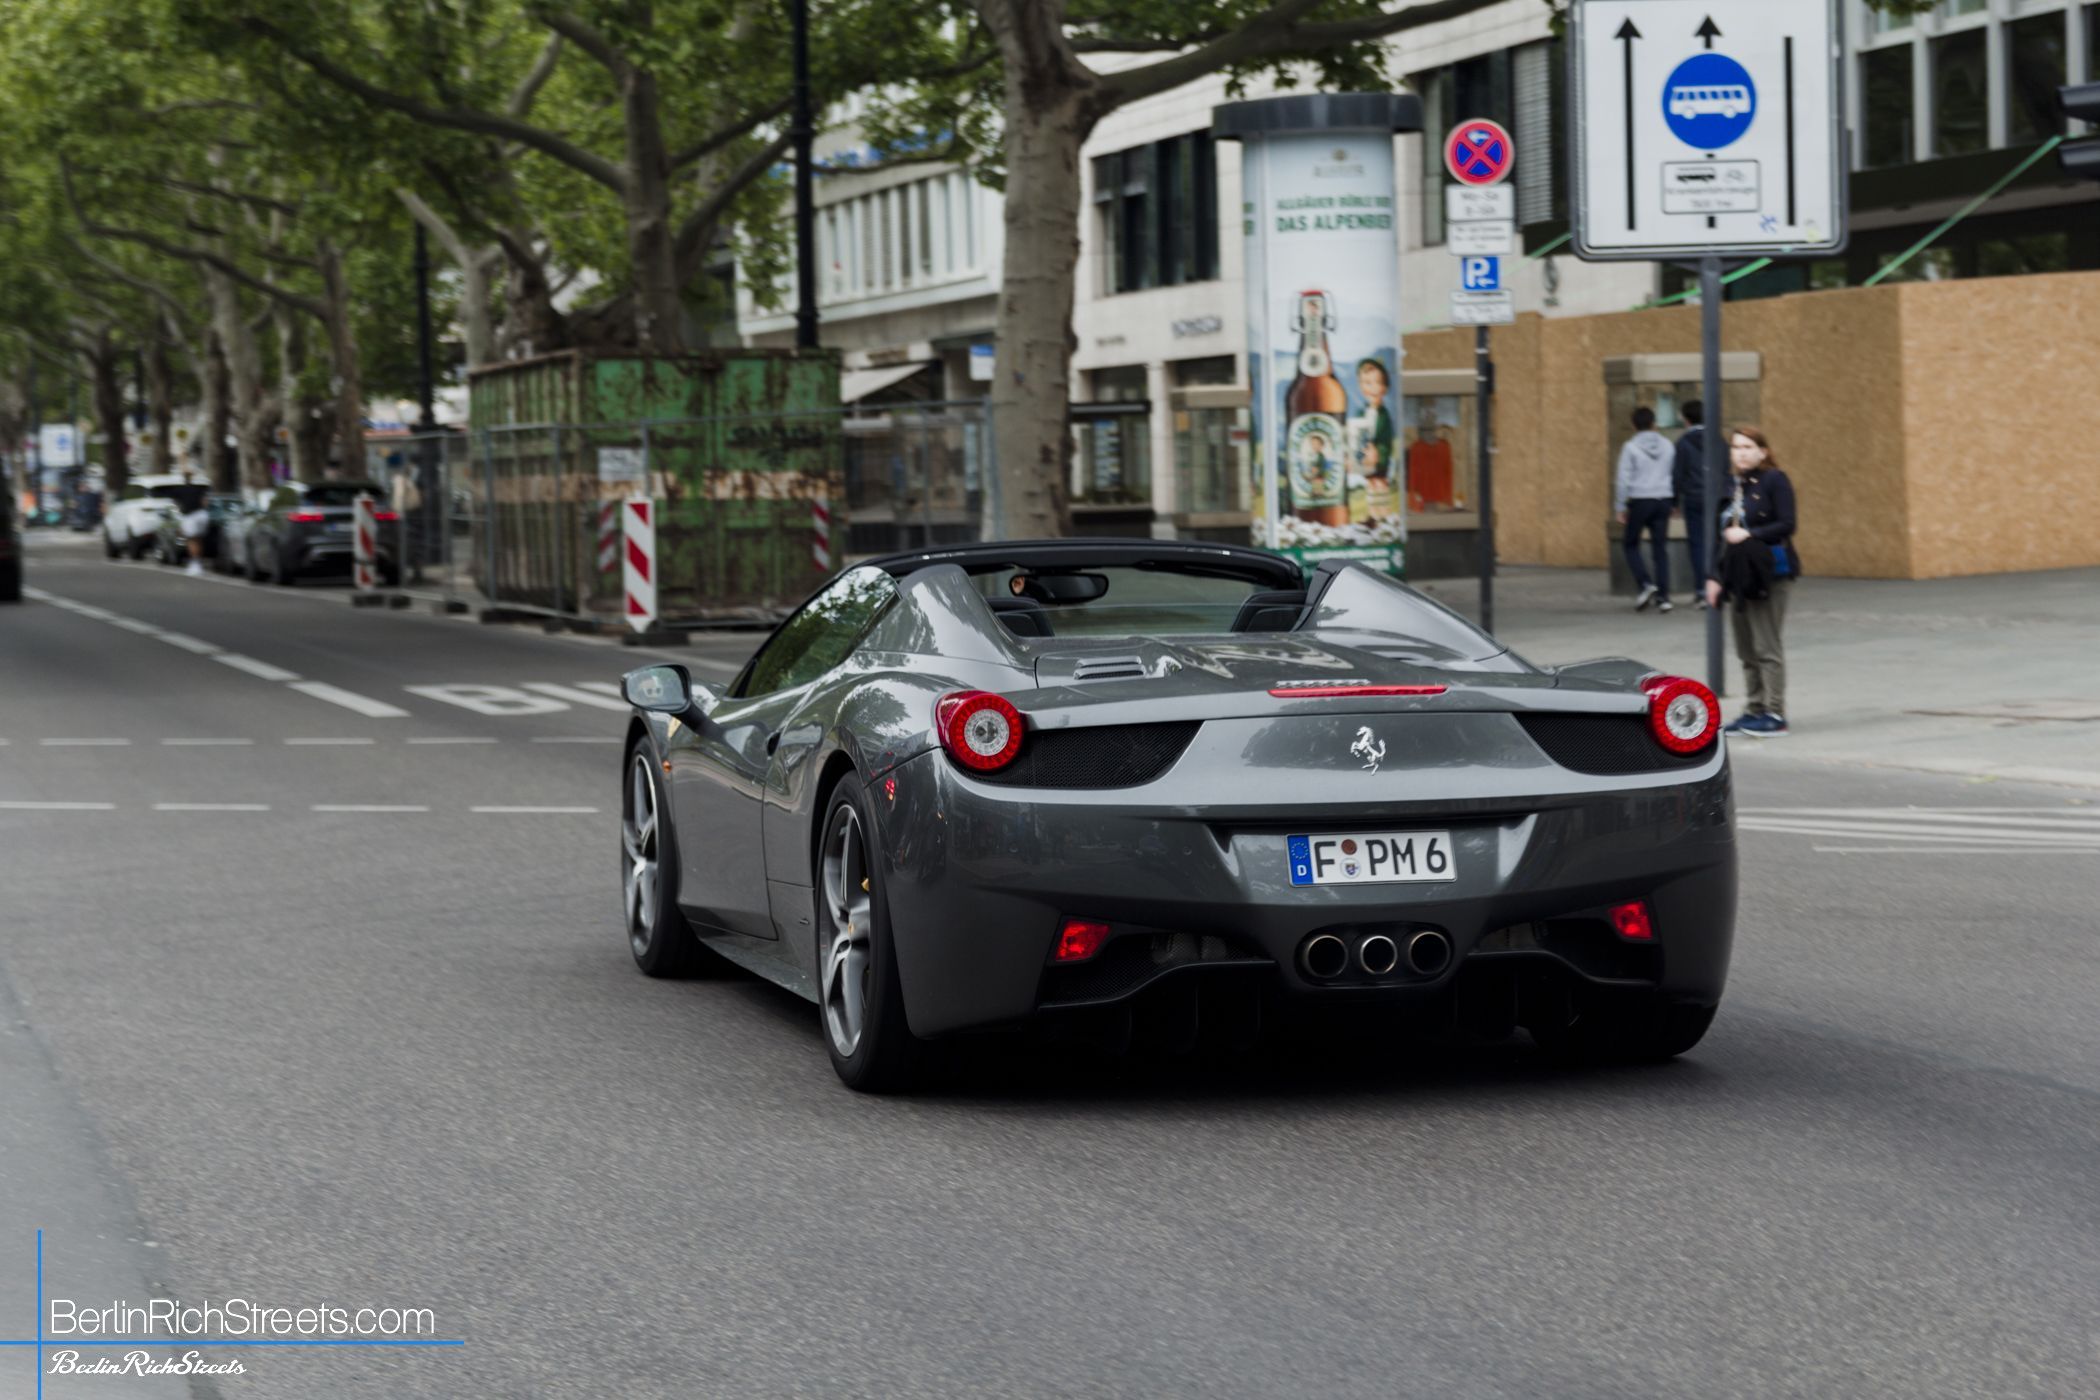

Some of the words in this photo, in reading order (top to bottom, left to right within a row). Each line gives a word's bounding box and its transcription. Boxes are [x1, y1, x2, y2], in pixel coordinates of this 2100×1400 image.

[1276, 216, 1308, 232] DAS
[1467, 258, 1490, 288] P
[1313, 841, 1336, 878] F
[1365, 838, 1417, 876] PM
[1426, 838, 1447, 874] 6
[1297, 865, 1307, 876] D
